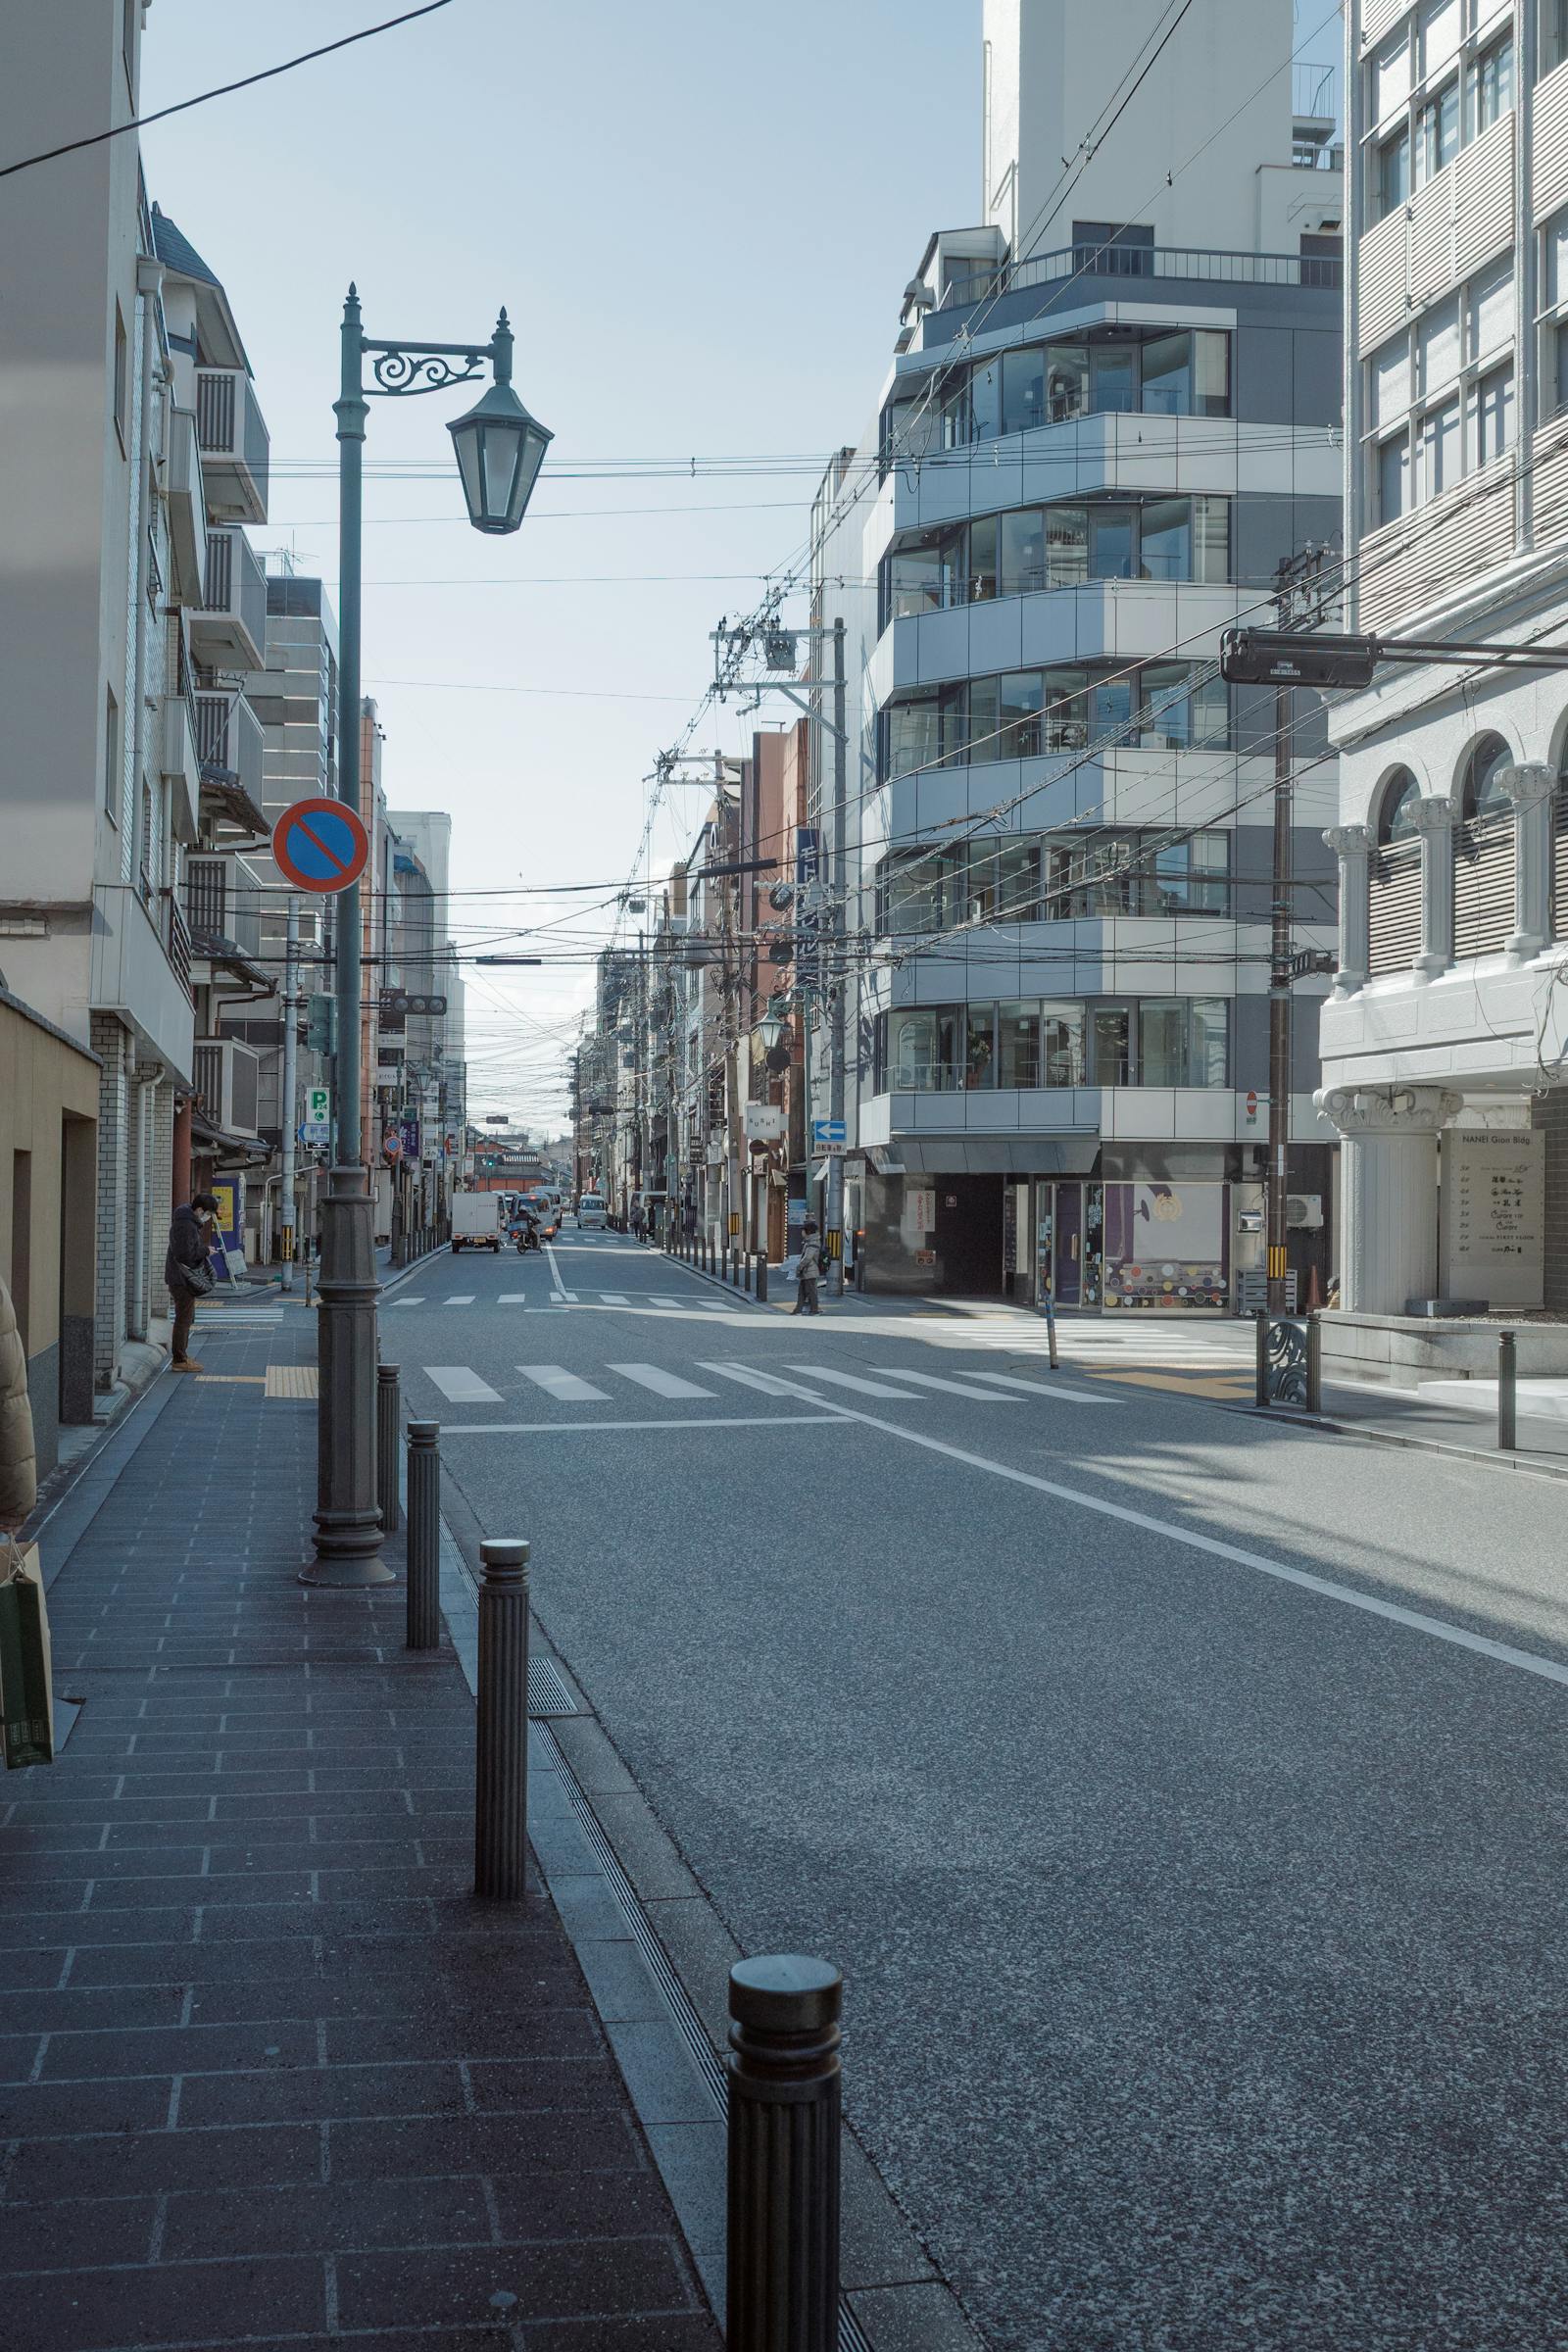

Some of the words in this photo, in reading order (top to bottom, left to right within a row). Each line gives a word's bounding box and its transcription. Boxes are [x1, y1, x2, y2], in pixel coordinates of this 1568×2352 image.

[313, 1091, 327, 1109] P
[1462, 1135, 1489, 1144] NANEI
[1491, 1135, 1511, 1145] Gion
[1512, 1135, 1532, 1146] Bldg
